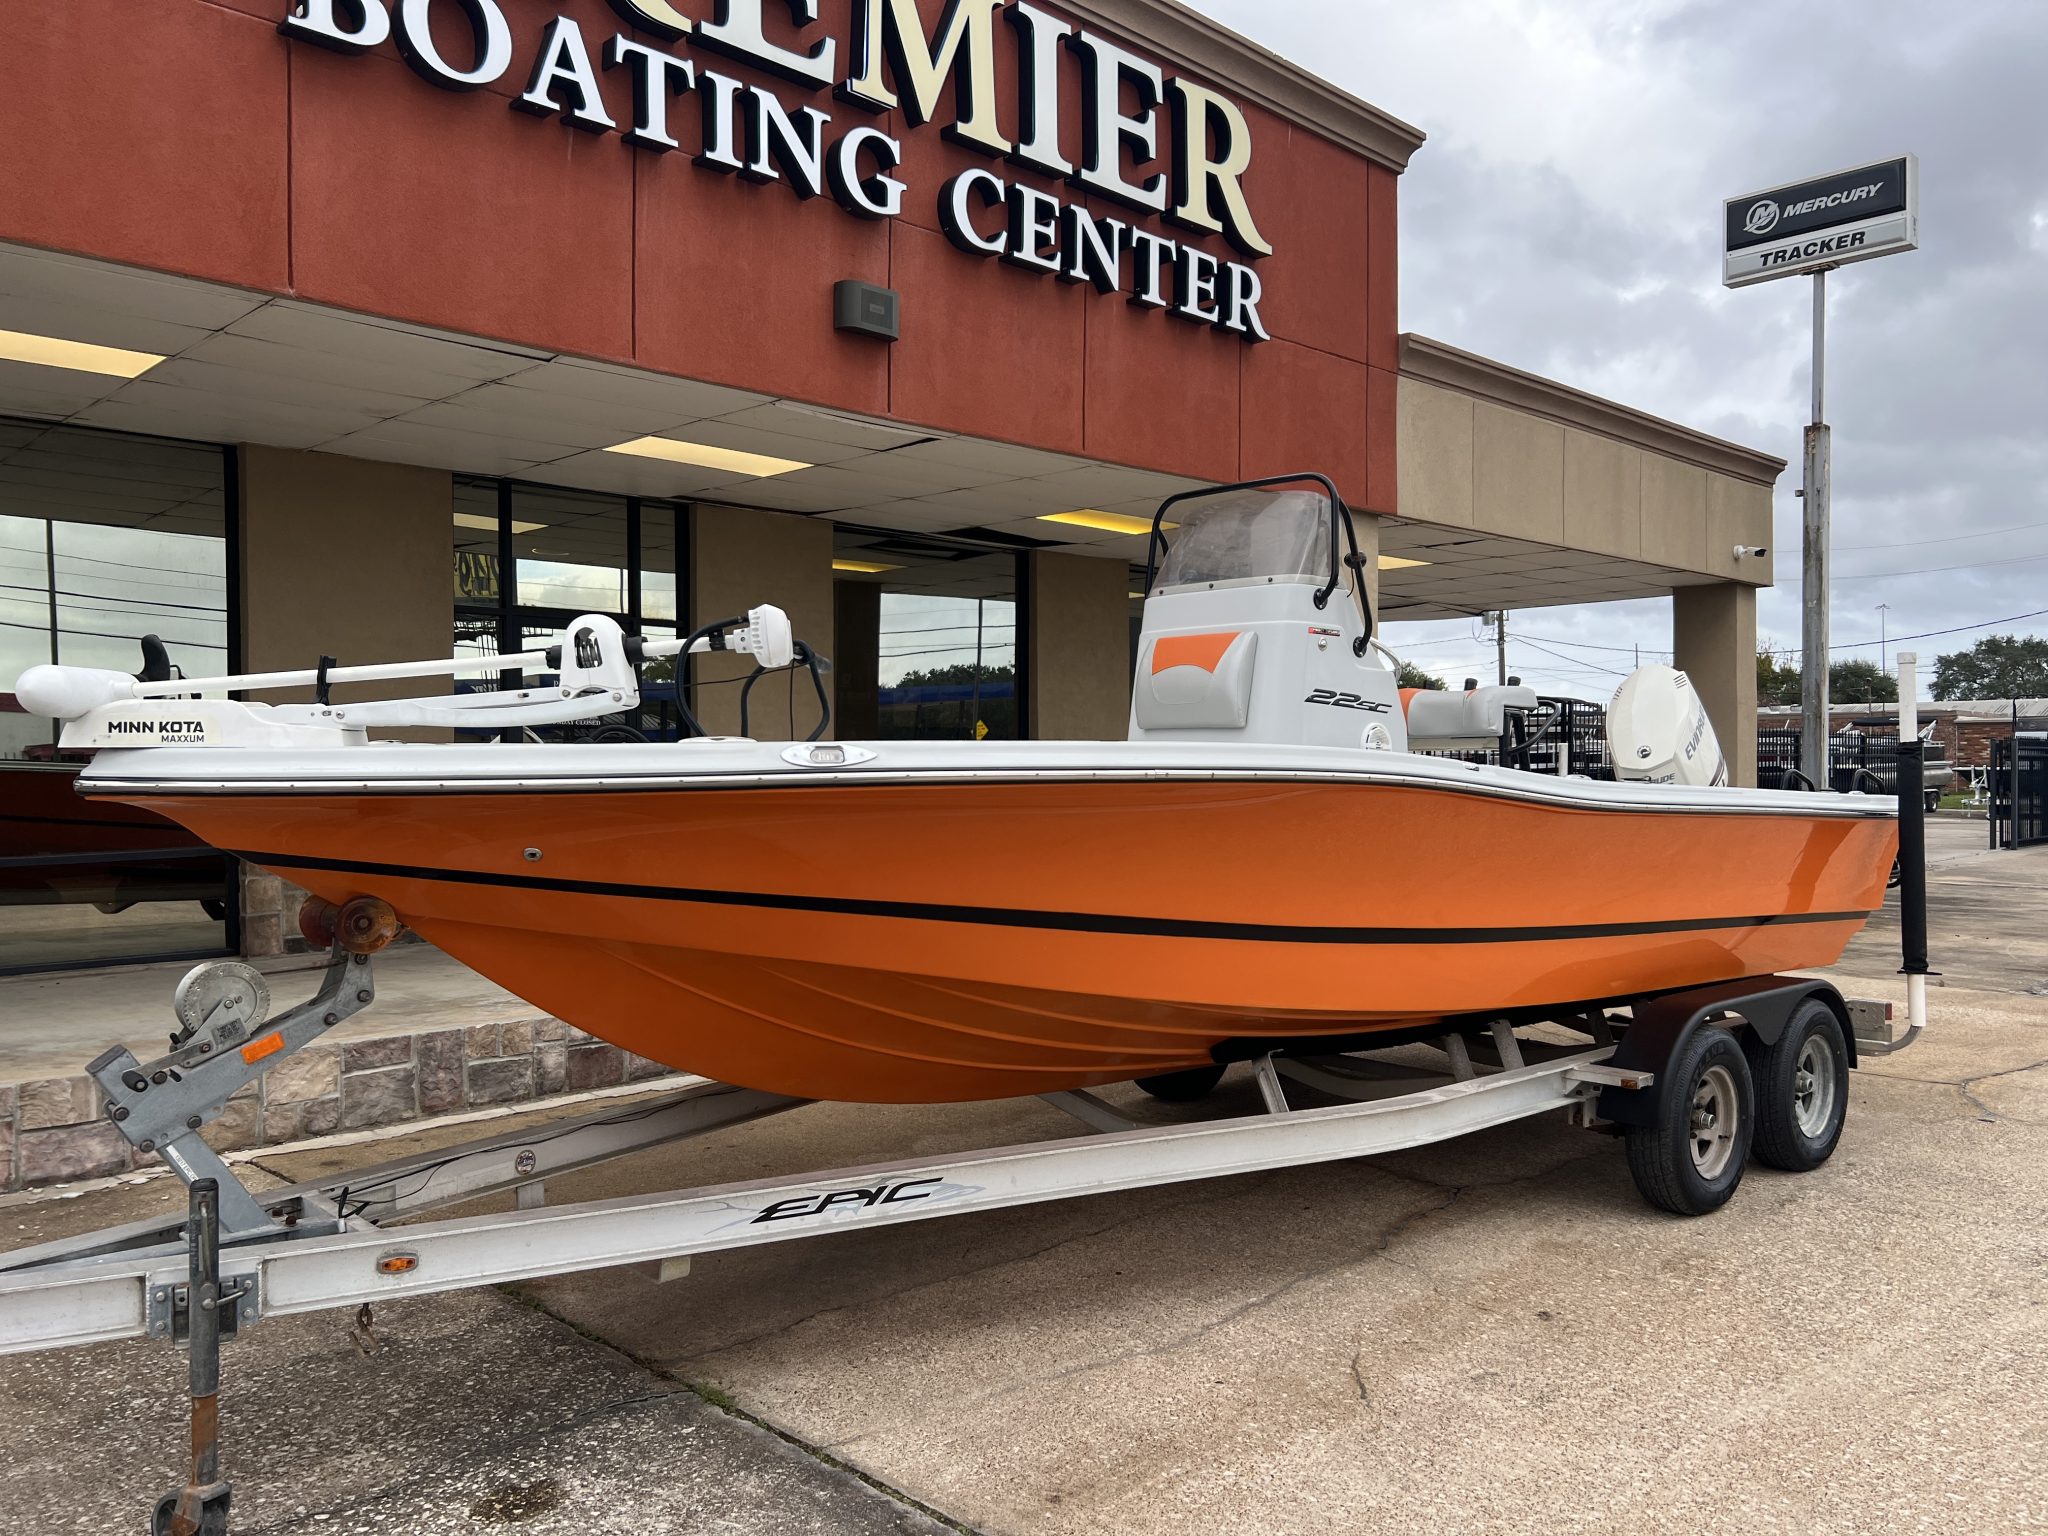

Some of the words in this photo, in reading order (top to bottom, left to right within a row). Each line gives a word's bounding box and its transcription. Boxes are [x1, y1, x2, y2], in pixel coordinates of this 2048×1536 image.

[1782, 181, 1884, 218] MERCURY
[951, 167, 1271, 341] CENTER
[1760, 231, 1866, 267] TRACKER
[108, 721, 154, 733] MINN
[159, 721, 205, 733] KOTA
[161, 734, 205, 743] MAXXUM
[750, 1176, 944, 1224] EPIC
